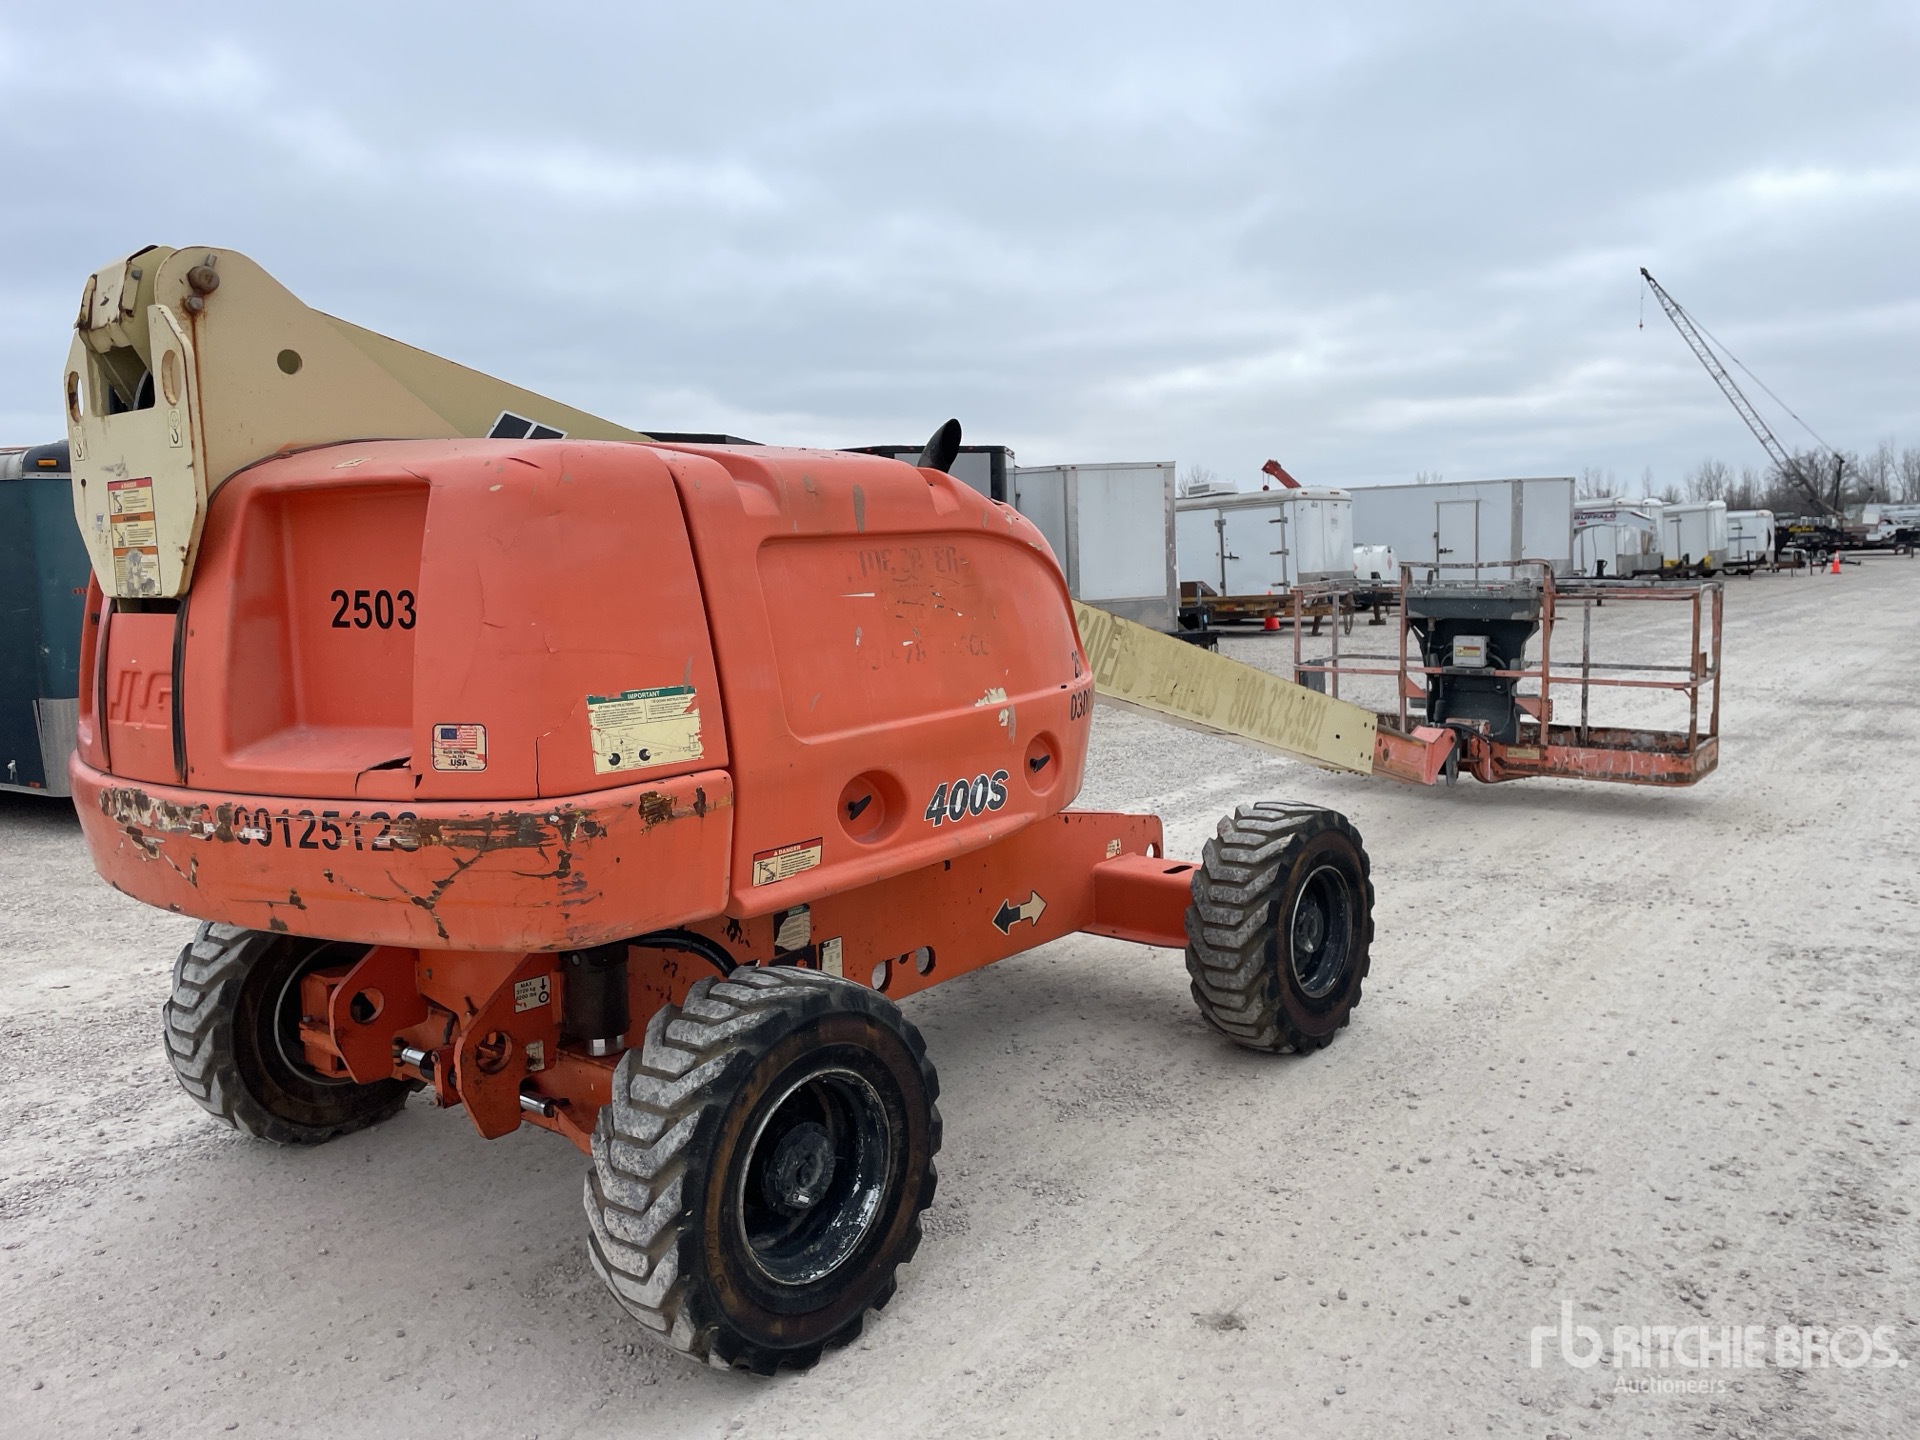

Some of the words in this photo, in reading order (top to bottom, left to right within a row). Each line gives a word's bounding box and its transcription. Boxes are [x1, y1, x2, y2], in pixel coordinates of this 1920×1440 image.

[330, 589, 417, 629] 2503
[627, 690, 660, 700] IMPORTANT
[924, 768, 1010, 828] 400S
[778, 845, 801, 855] DANGER
